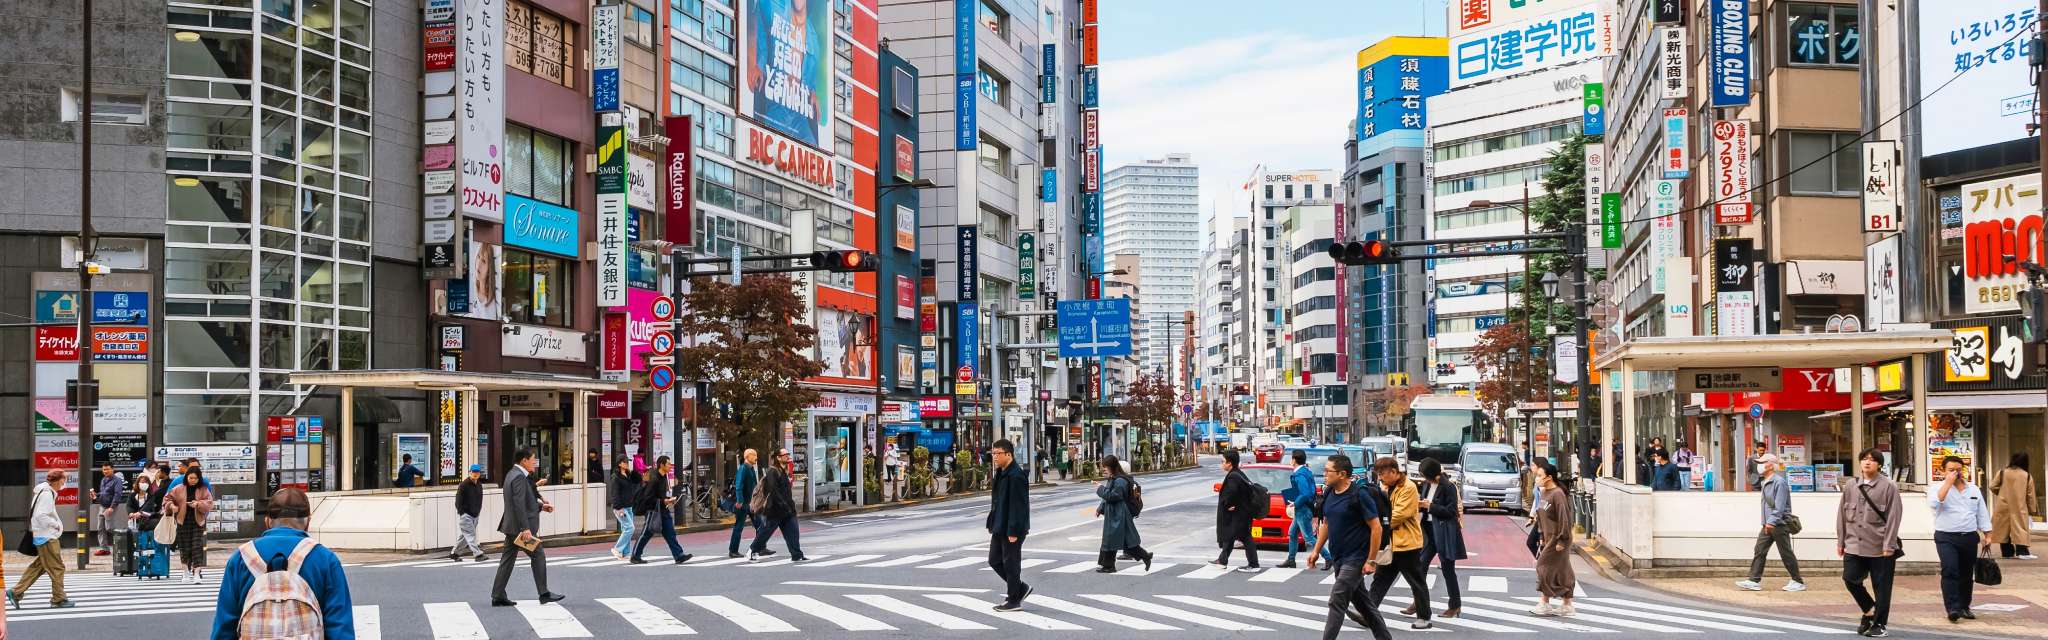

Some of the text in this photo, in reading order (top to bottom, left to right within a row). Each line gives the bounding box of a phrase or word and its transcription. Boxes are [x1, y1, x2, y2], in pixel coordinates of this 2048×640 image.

[1458, 11, 1597, 80] 日建学院
[1722, 0, 1744, 97] BOXING CLUB
[749, 127, 834, 188] BIC CAMERA
[598, 165, 624, 175] SMBC
[671, 151, 686, 211] Rakuten
[1265, 174, 1292, 183] SUPER
[1871, 214, 1891, 230] B1
[603, 198, 620, 301] 三井住友銀行
[656, 302, 670, 316] 40
[1670, 304, 1689, 314] UQ
[599, 400, 626, 409] Rakuten
